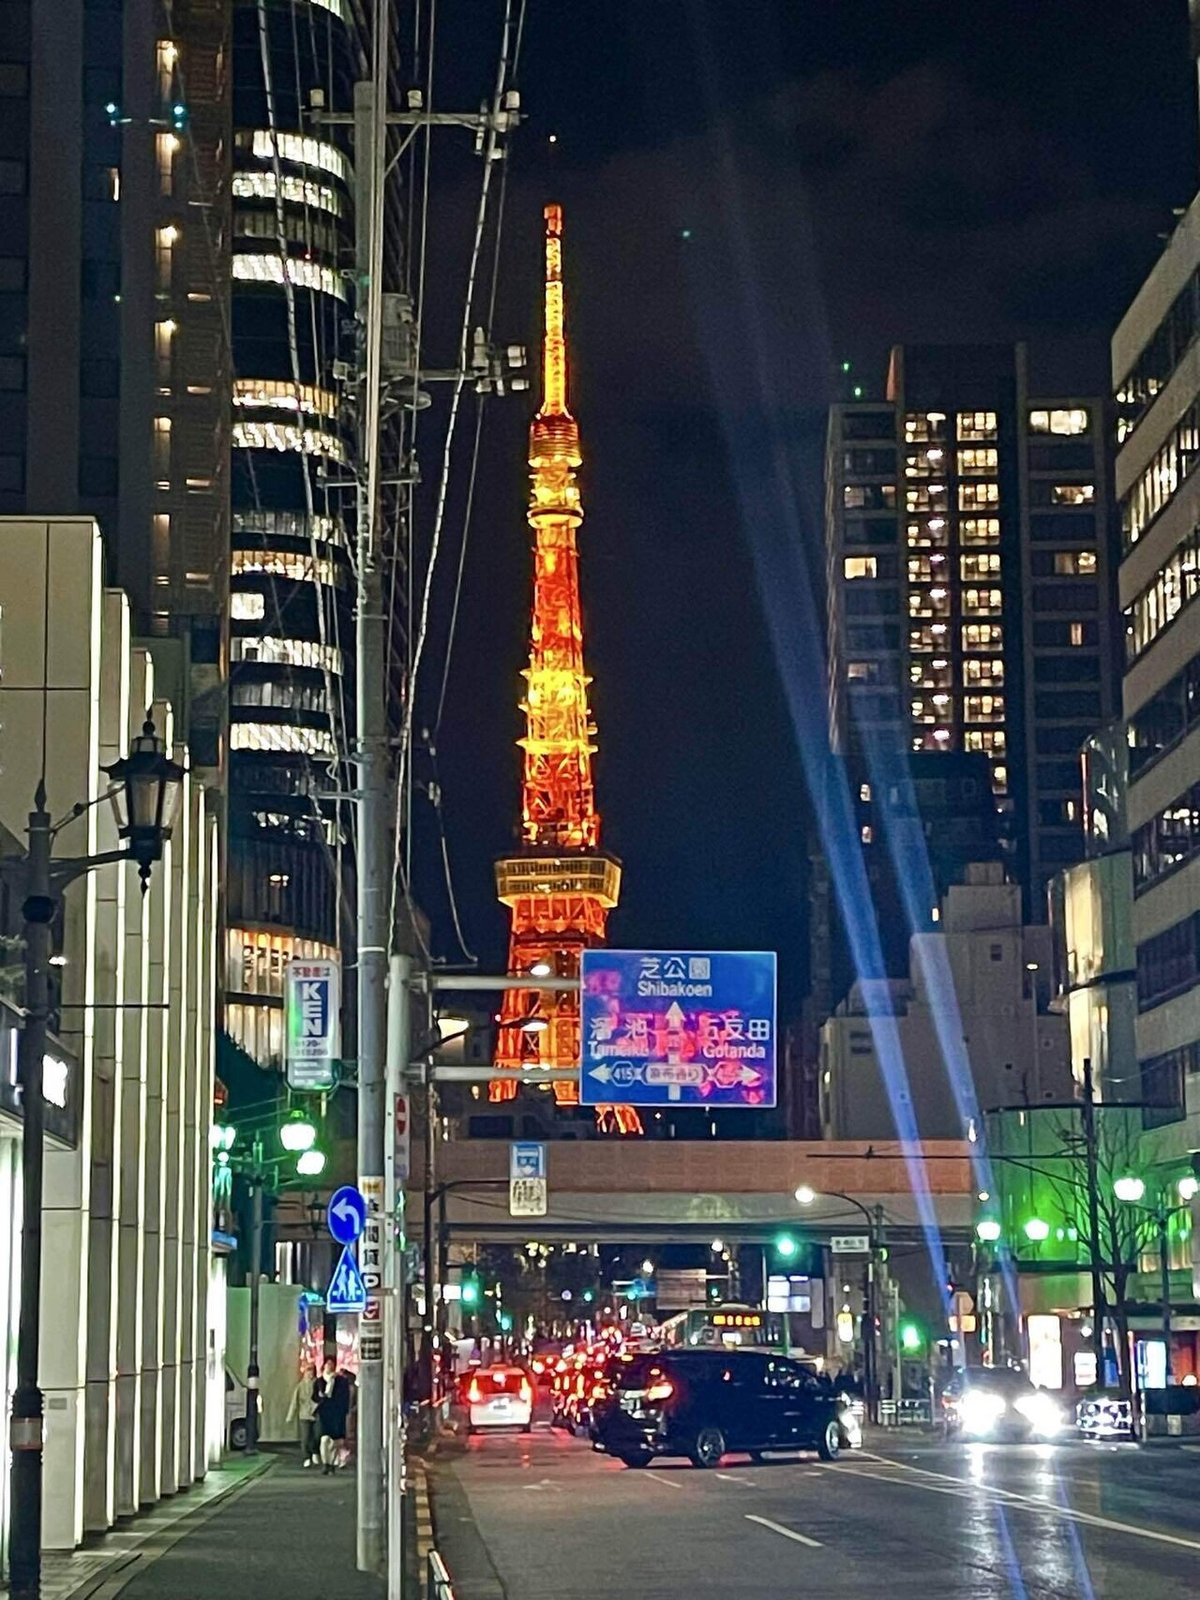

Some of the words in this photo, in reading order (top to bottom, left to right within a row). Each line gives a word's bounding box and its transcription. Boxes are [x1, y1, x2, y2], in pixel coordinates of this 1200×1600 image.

[637, 980, 713, 998] Shibakoen
[302, 982, 323, 1036] KEN
[703, 1043, 766, 1059] Gotanda
[613, 1067, 634, 1081] 415
